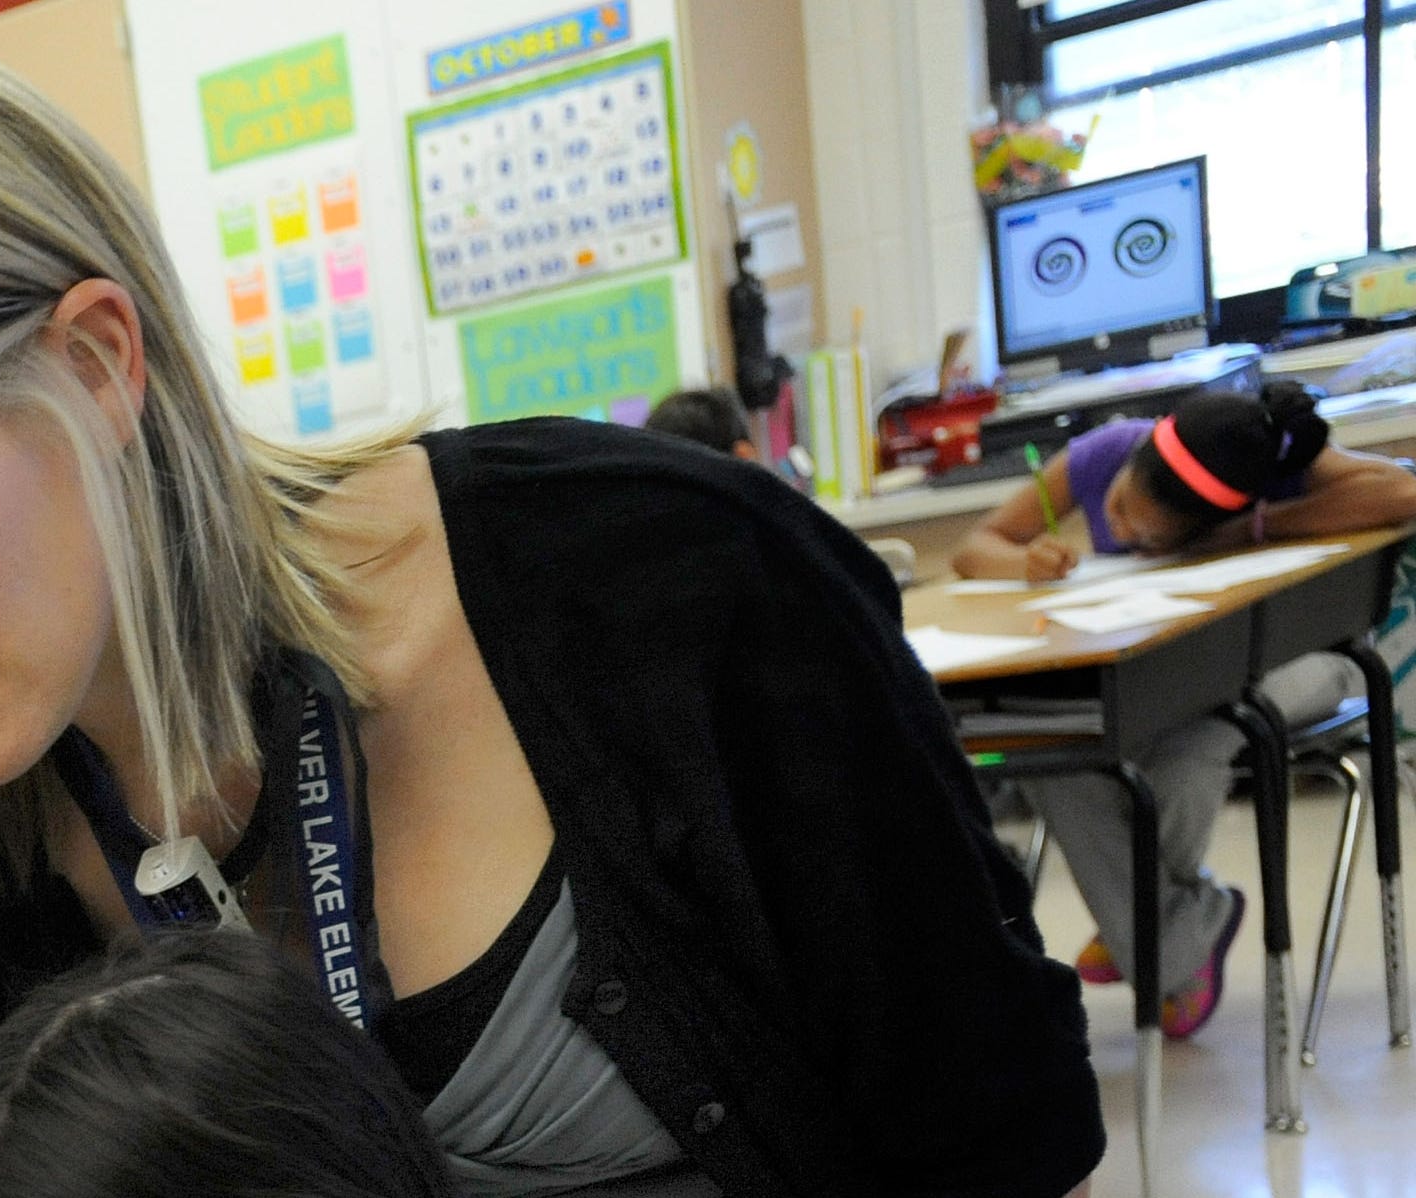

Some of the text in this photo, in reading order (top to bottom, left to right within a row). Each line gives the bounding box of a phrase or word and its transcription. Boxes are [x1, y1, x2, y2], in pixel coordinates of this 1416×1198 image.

[434, 20, 582, 84] OCTOBER
[302, 815, 346, 916] LAKE
[318, 922, 366, 1031] ELEM
